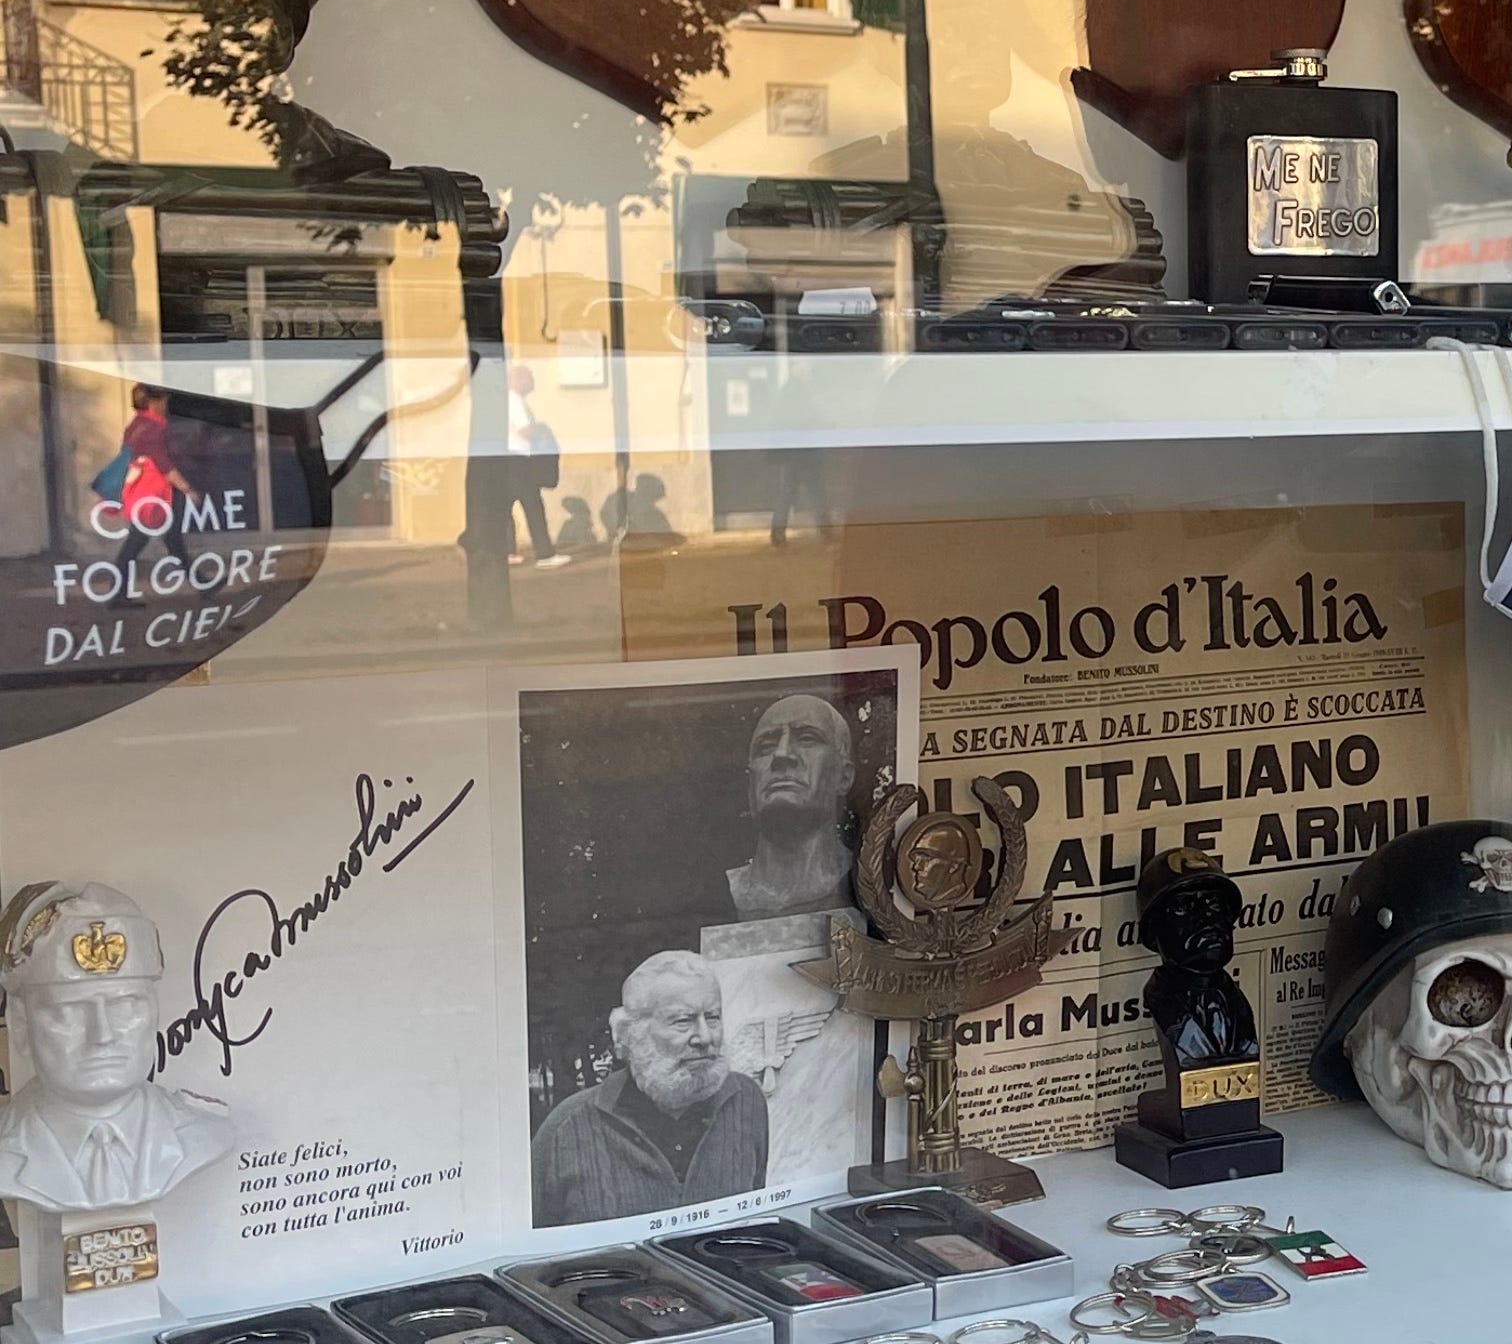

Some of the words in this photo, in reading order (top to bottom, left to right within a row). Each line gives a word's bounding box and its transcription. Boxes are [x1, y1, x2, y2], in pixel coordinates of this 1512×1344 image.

[90, 489, 246, 539] COME
[53, 545, 282, 605] FOLGORE
[44, 620, 125, 666] DAL
[727, 602, 789, 657] Il
[818, 585, 1115, 690] Popolo
[1133, 571, 1390, 654] d'Italia
[1077, 668, 1111, 681] BENITO
[1114, 663, 1160, 678] MUSSOLINI
[952, 723, 1088, 754] SEGNATA
[1099, 714, 1151, 744] DAL
[1161, 702, 1275, 735] DESTINO
[1282, 694, 1300, 725] È
[1307, 686, 1427, 721] SCOCCATA
[1065, 734, 1381, 820] ITALIANO
[1043, 817, 1224, 892] ALLE
[1276, 981, 1287, 1004] al
[1289, 980, 1305, 1002] Re
[956, 1002, 1044, 1047] arla
[1191, 1073, 1254, 1102] DUX
[238, 1151, 288, 1171] Siate
[290, 1139, 348, 1167] felici,
[239, 1175, 277, 1193] non
[284, 1169, 330, 1188] sono
[336, 1158, 397, 1180] morto,
[240, 1198, 287, 1216] sono
[293, 1186, 360, 1209] ancora
[366, 1175, 396, 1203] qui
[401, 1171, 433, 1190] con
[438, 1161, 464, 1182] voi
[241, 1222, 276, 1239] con
[283, 1213, 328, 1233] tutta
[334, 1200, 412, 1225] l'anima.
[401, 1228, 464, 1256] Vittorio
